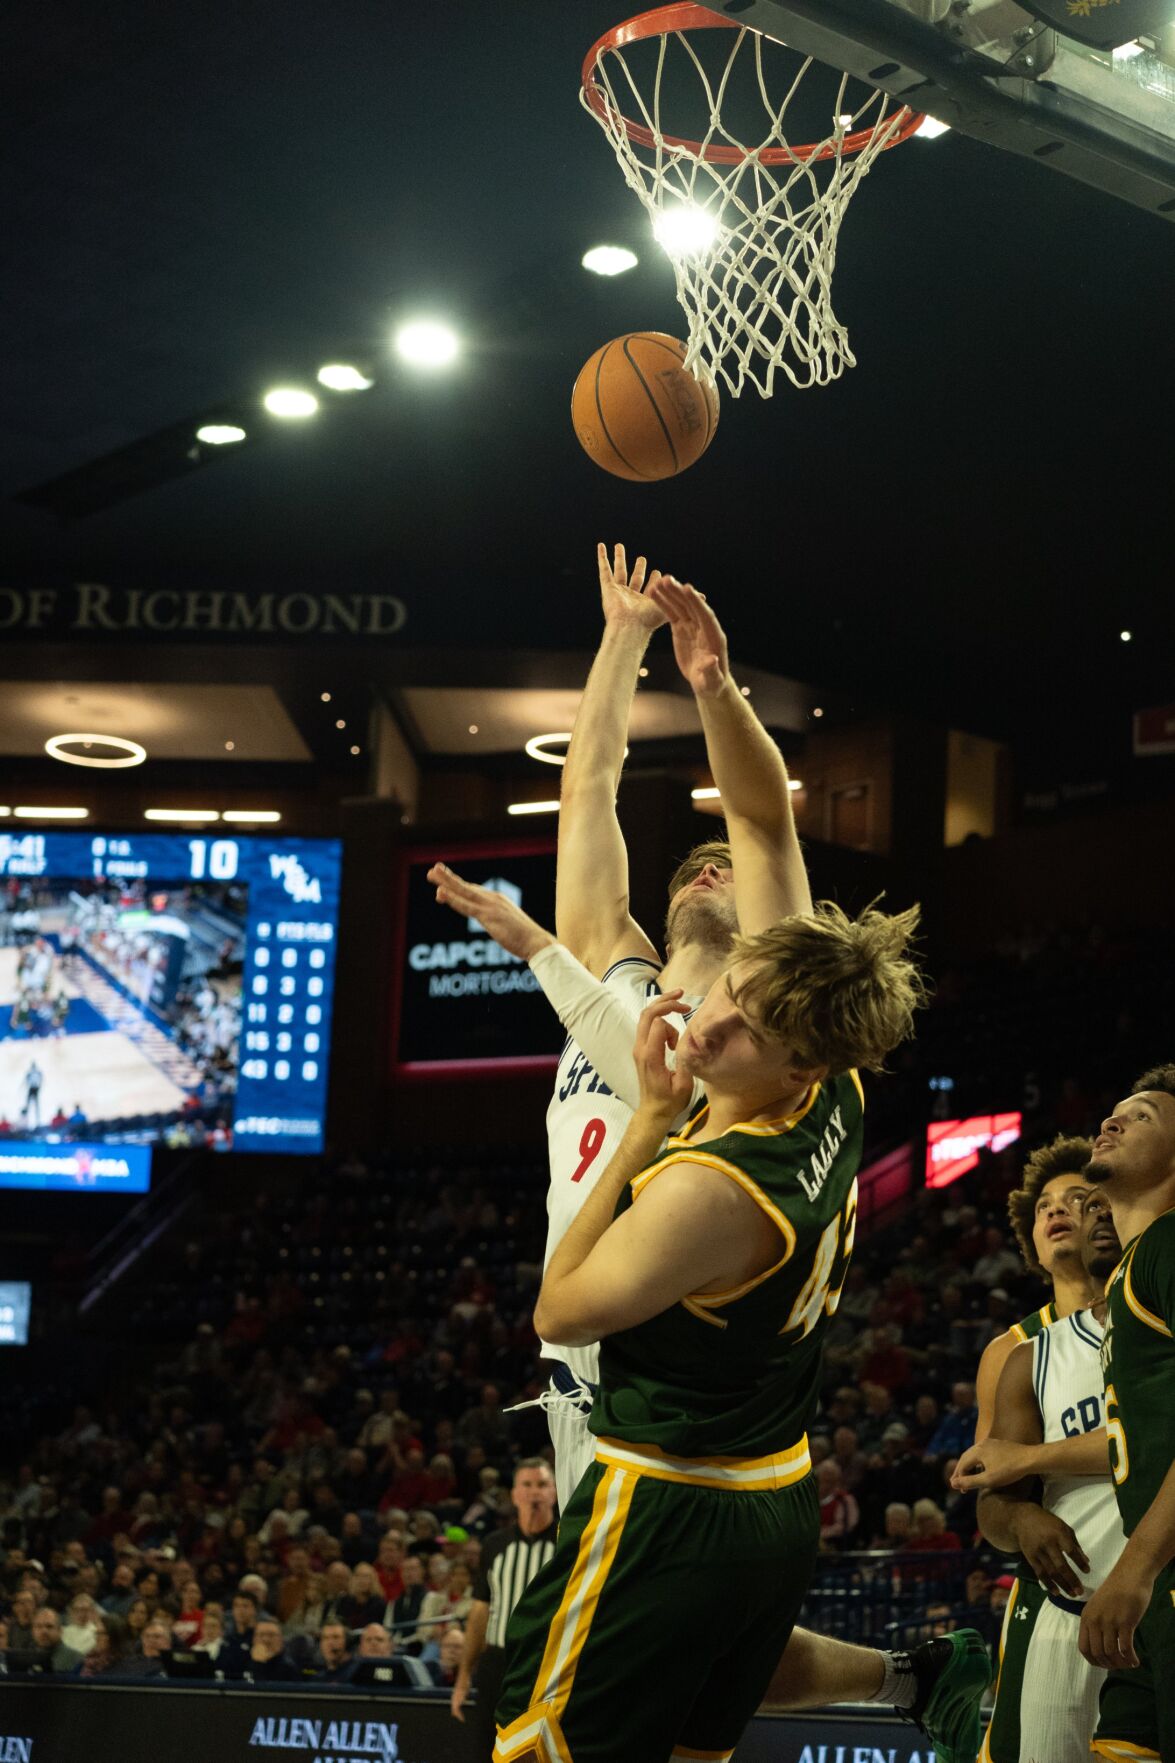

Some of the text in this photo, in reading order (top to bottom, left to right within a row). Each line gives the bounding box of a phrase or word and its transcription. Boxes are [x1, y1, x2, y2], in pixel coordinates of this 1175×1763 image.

[75, 582, 408, 635] RICHMOND
[190, 840, 239, 879] 10
[570, 1118, 607, 1183] 9
[796, 1105, 848, 1203] LALLY
[1061, 1393, 1106, 1438] SP
[249, 1716, 322, 1749] ALLEN
